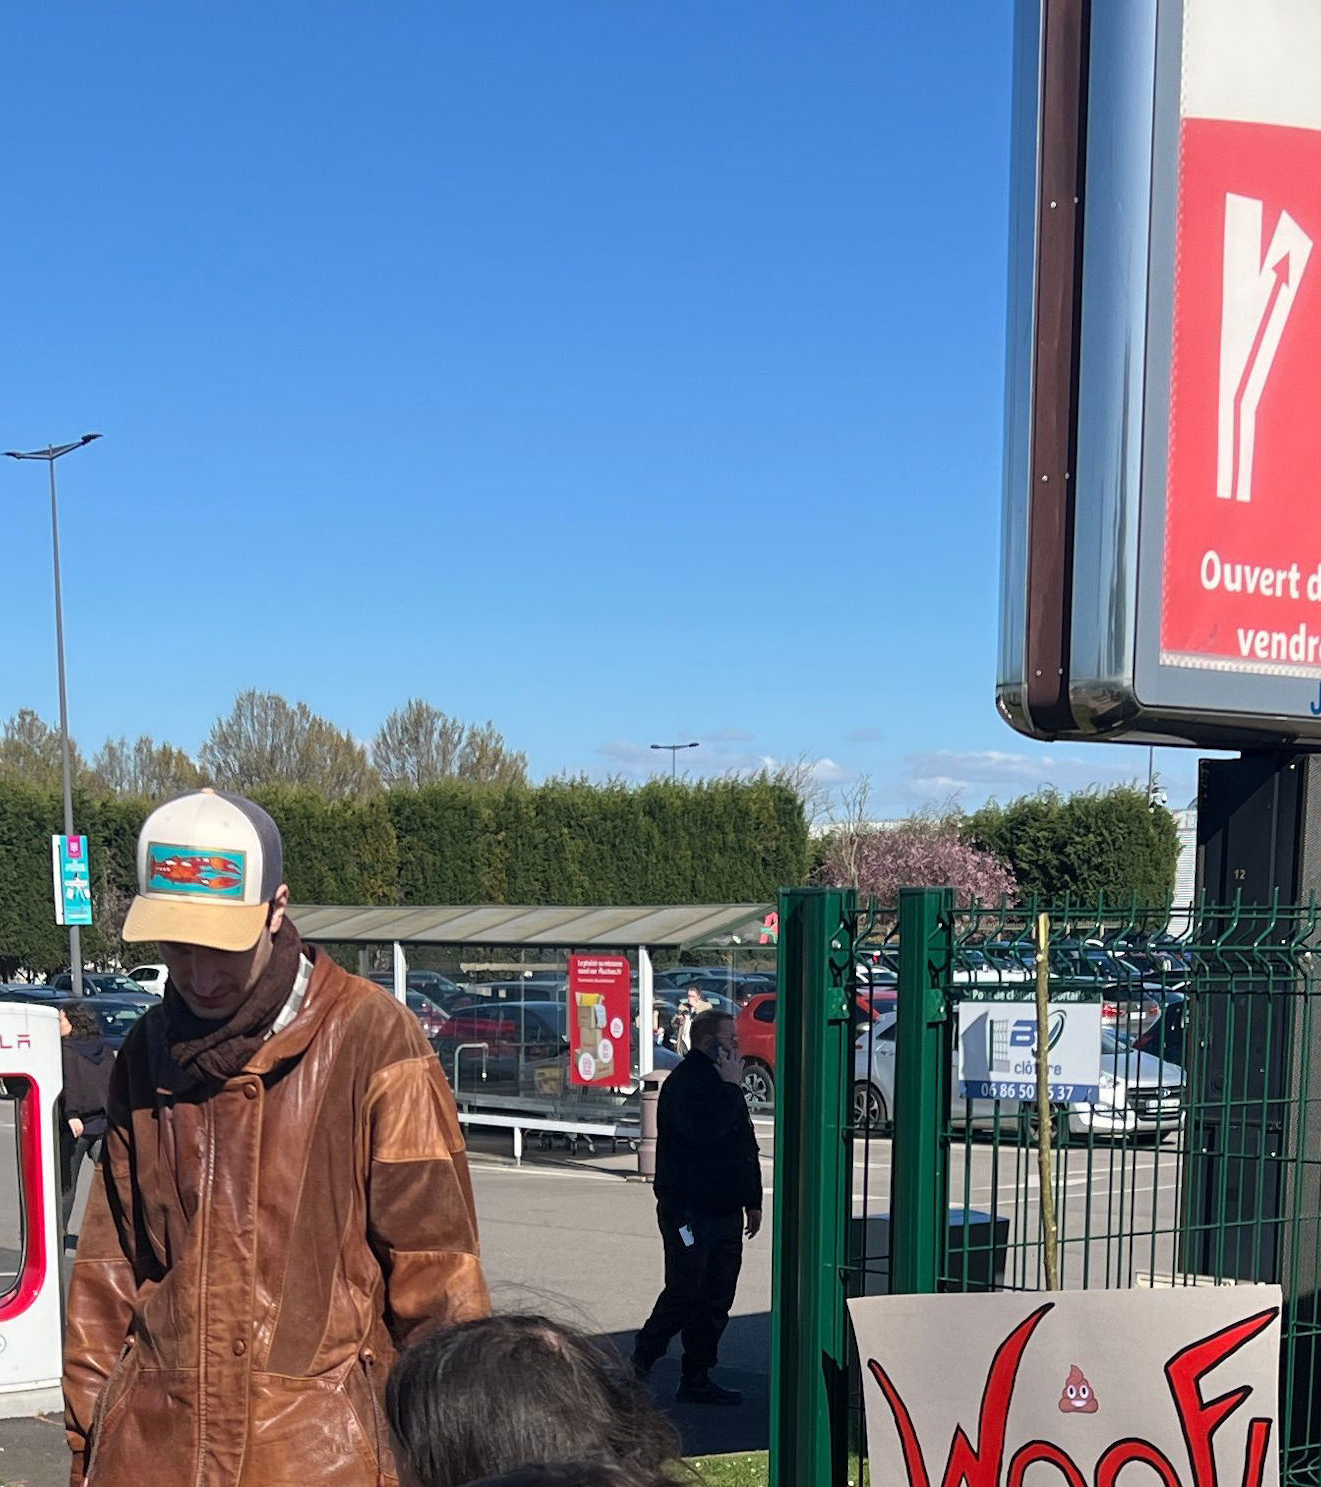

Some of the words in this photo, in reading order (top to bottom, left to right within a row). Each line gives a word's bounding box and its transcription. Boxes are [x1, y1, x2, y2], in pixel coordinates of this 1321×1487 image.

[1201, 550, 1301, 600] Ouvert
[1234, 868, 1247, 880] 12
[981, 1082, 997, 1097] 06
[1000, 1083, 1016, 1099] 86
[1019, 1084, 1035, 1100] 50
[1057, 1086, 1074, 1101] 37
